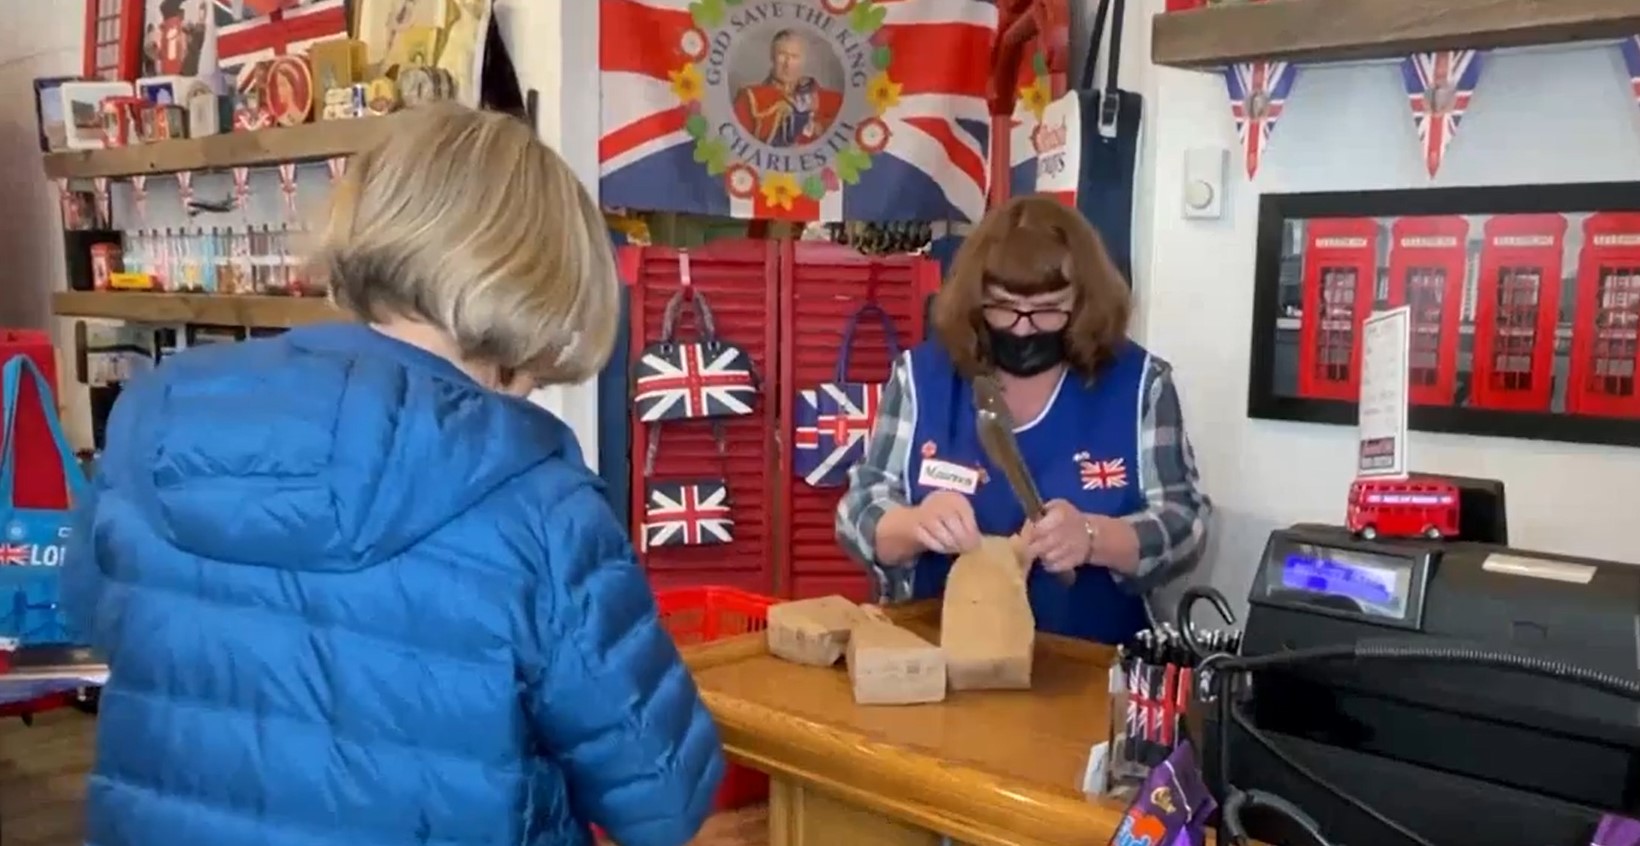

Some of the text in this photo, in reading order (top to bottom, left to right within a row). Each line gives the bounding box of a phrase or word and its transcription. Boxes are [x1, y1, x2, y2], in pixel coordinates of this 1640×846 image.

[706, 2, 868, 88] GOD SAVE THE KING
[719, 121, 855, 172] CHARLES III
